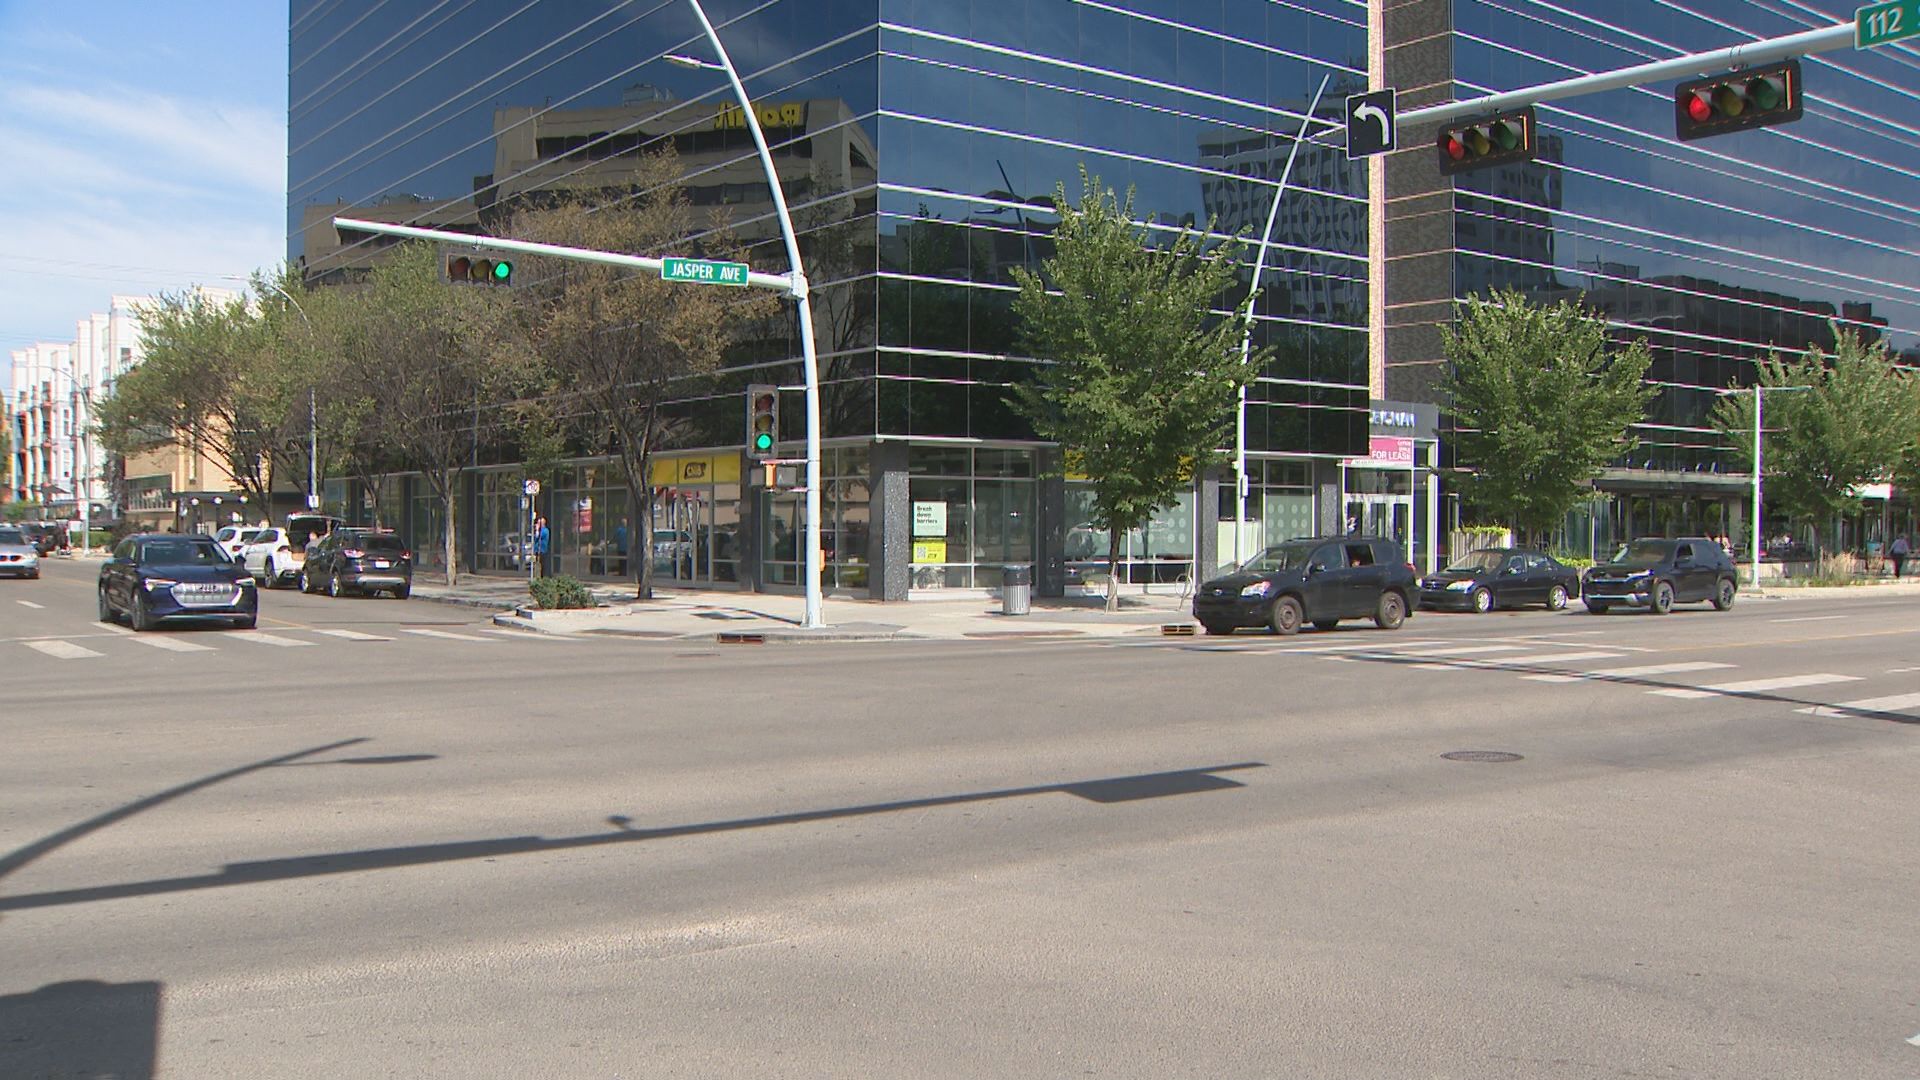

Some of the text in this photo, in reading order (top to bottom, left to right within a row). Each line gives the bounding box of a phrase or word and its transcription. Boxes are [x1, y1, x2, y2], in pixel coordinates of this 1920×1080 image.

[1866, 7, 1903, 38] 112
[671, 262, 741, 281] JASPER AVE
[1371, 450, 1387, 459] FOR
